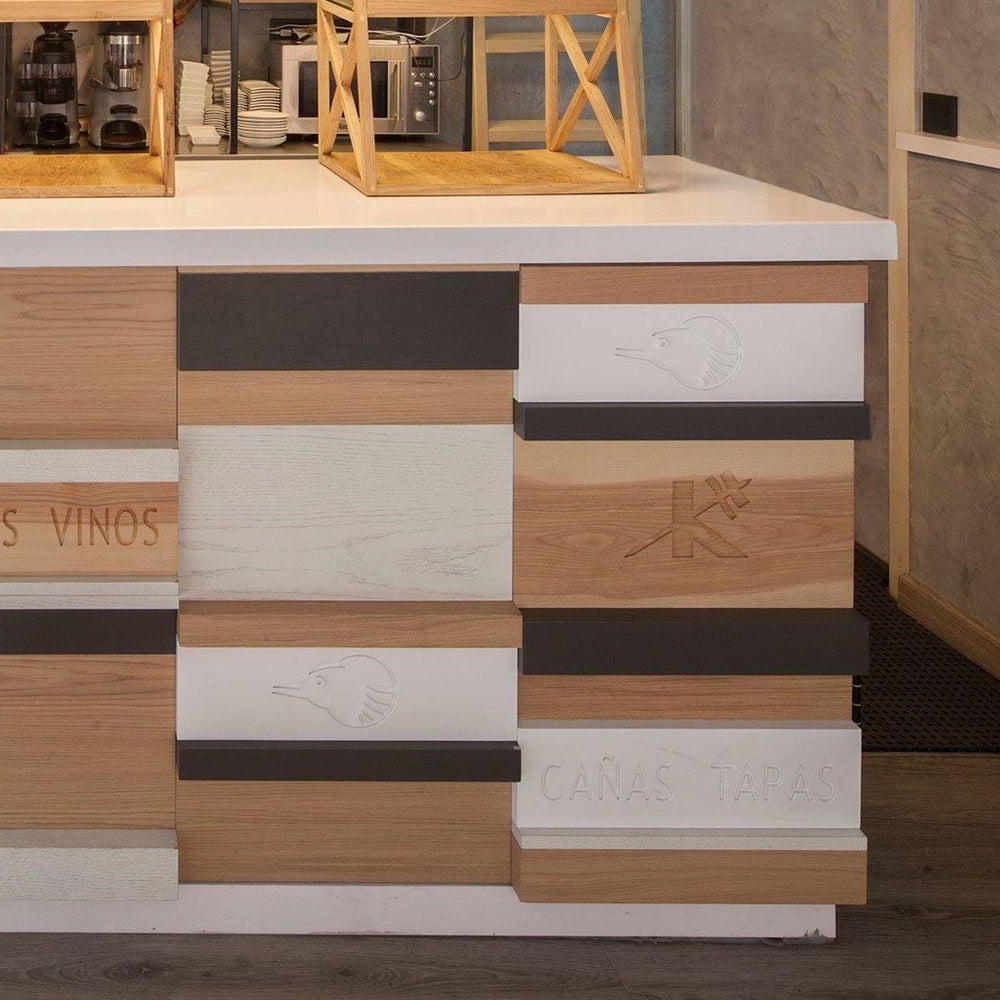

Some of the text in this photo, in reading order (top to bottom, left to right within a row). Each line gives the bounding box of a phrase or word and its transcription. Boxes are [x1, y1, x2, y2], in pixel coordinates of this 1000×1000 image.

[50, 507, 160, 547] VINOS
[540, 756, 837, 801] CAÑAS TAPAS
